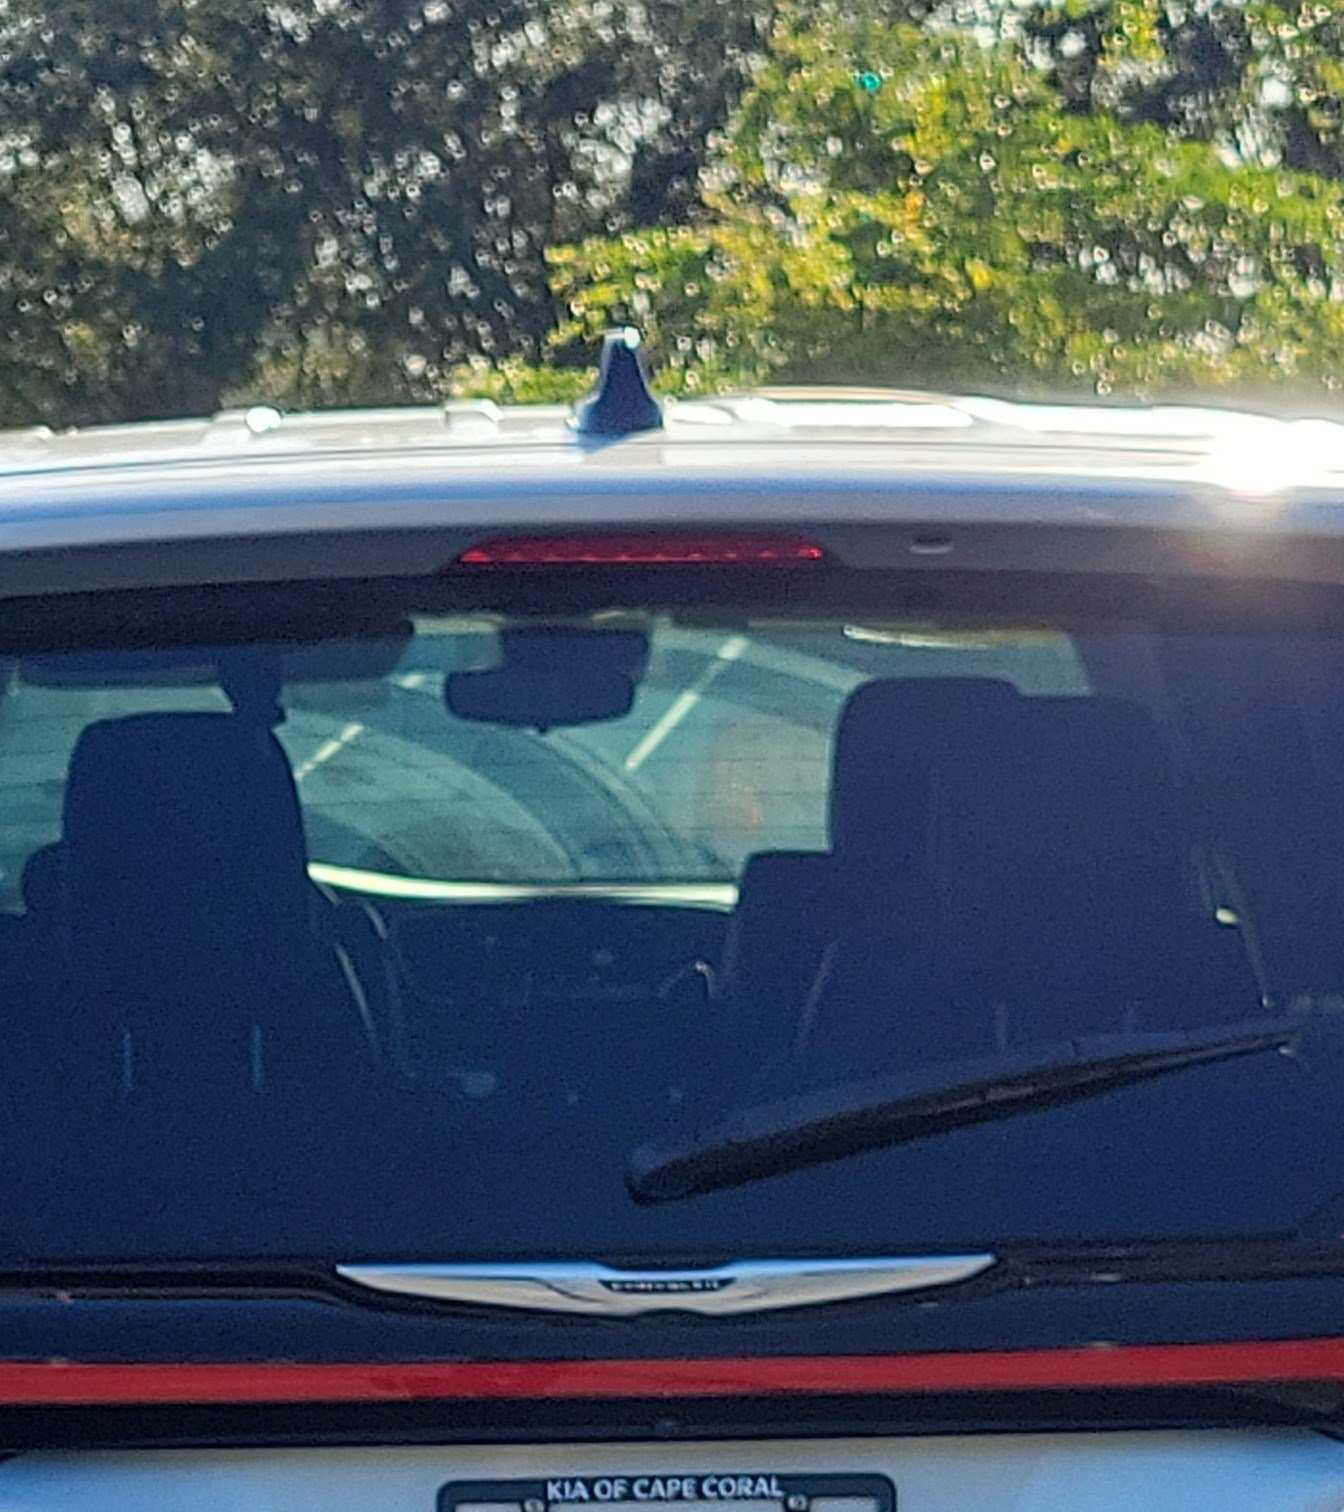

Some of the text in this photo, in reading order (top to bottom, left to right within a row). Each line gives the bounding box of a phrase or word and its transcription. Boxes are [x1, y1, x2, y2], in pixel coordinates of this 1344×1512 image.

[547, 1475, 784, 1500] KIA OF CAPE CORAL
